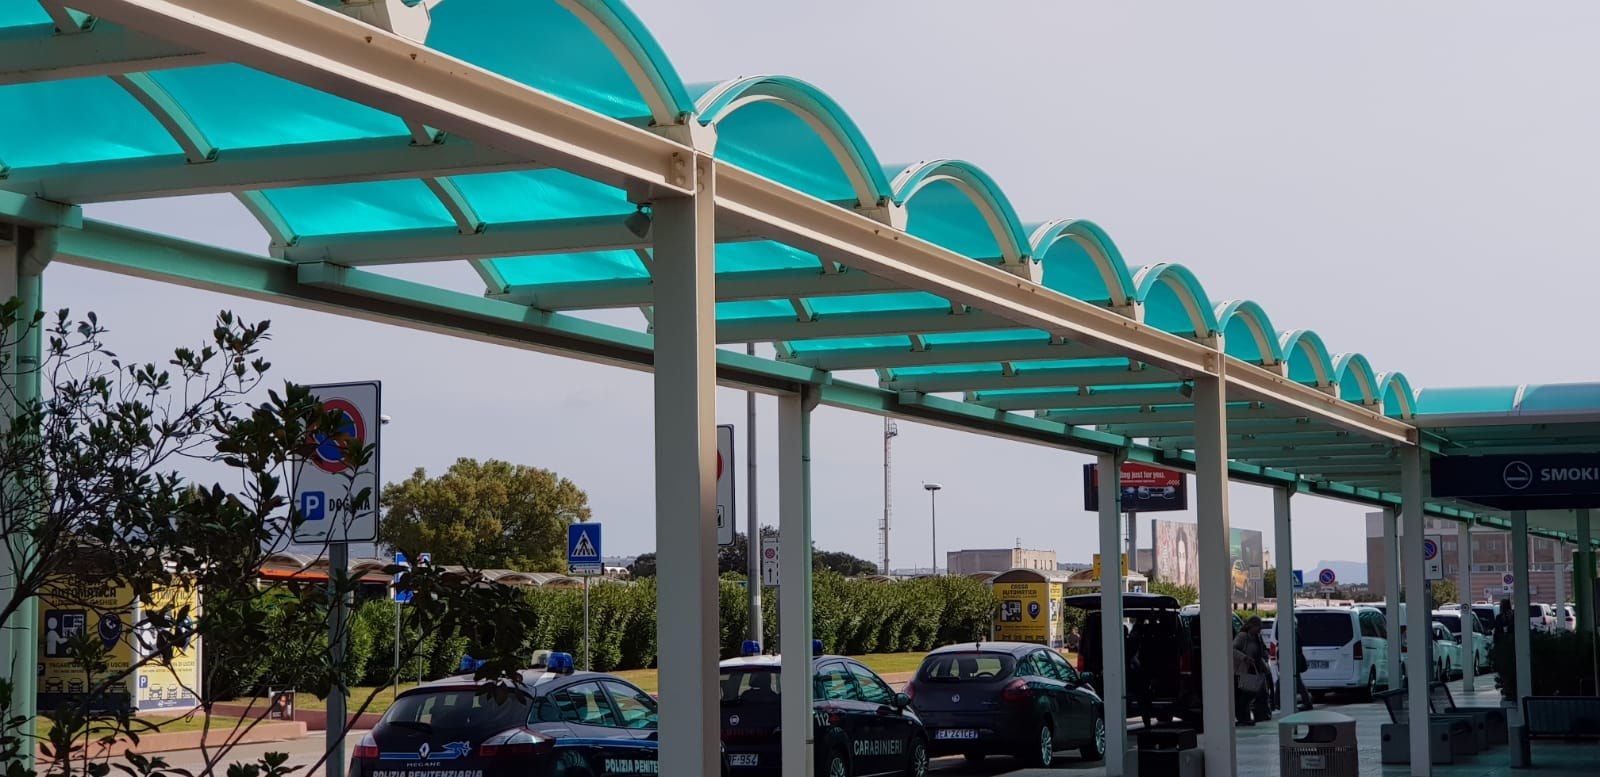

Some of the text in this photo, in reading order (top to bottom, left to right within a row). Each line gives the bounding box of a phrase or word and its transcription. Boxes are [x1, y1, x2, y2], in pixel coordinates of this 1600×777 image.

[1131, 471, 1143, 479] just
[1541, 468, 1599, 481] SMOKI
[306, 495, 319, 518] P
[814, 712, 831, 726] 112
[853, 739, 903, 756] CARABINIERI
[605, 758, 634, 773] POLIZIA
